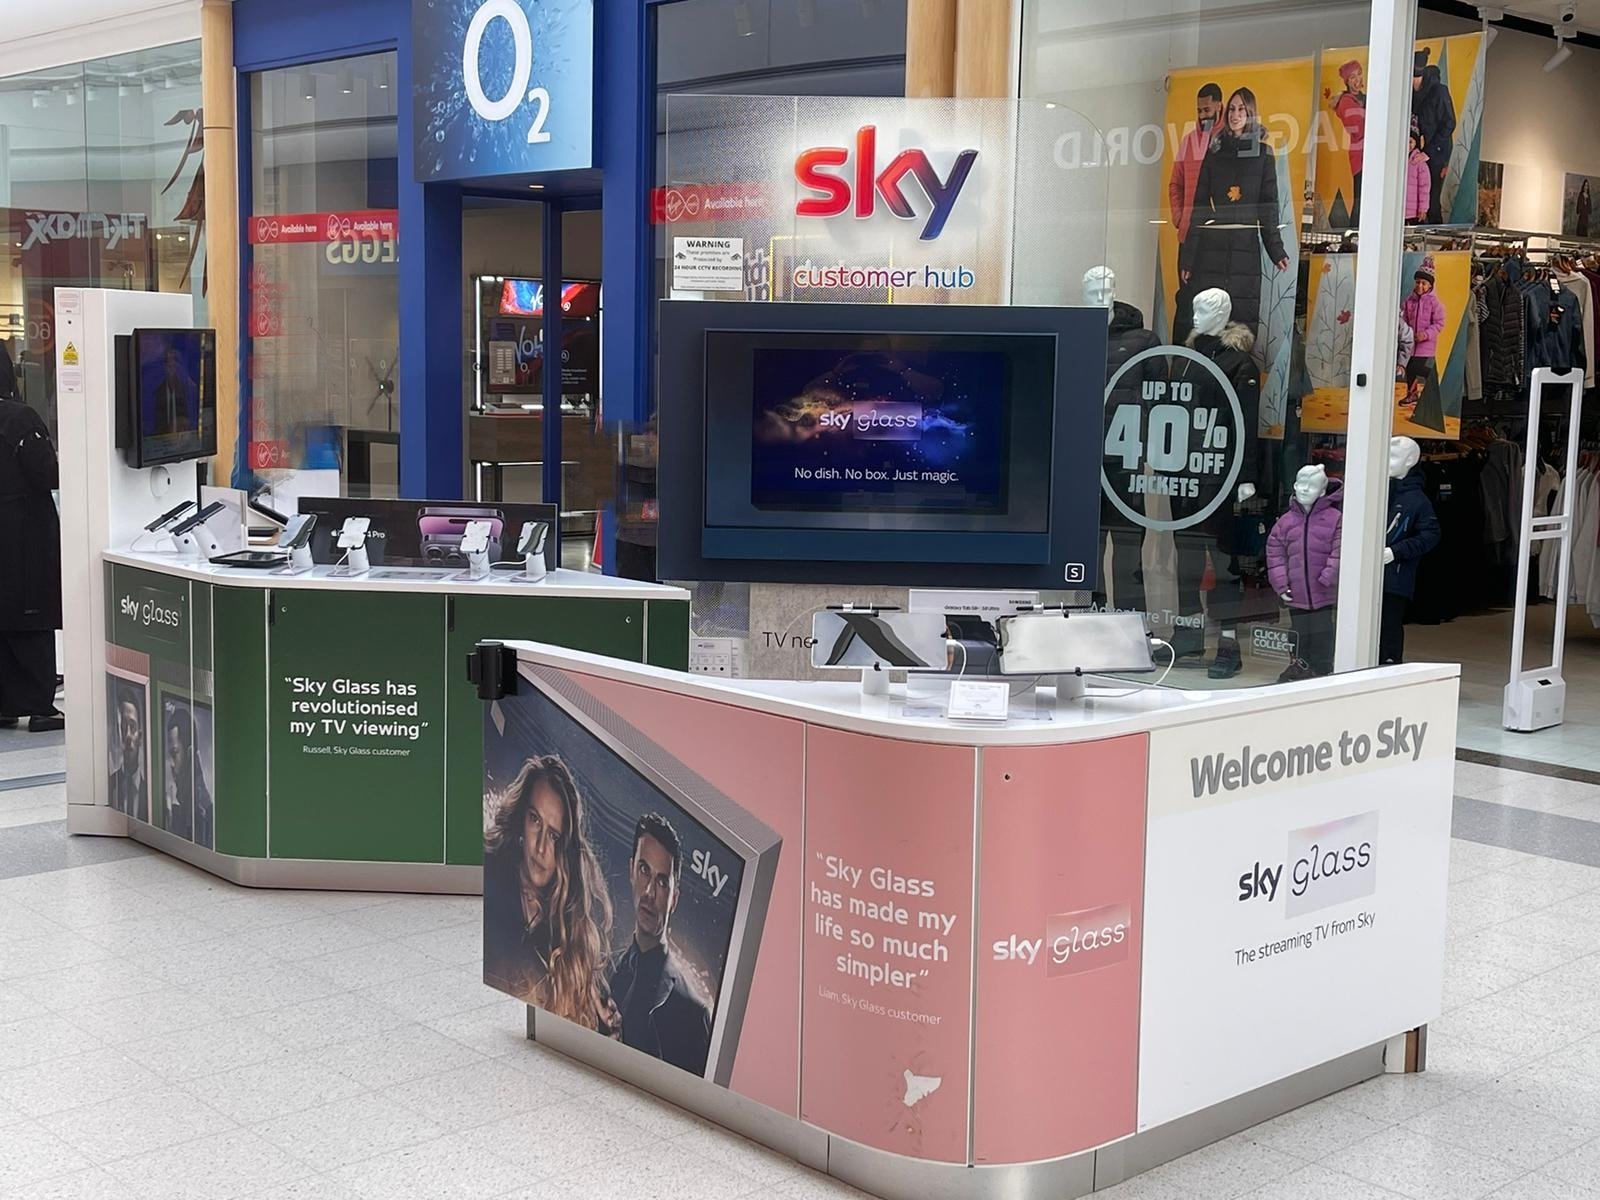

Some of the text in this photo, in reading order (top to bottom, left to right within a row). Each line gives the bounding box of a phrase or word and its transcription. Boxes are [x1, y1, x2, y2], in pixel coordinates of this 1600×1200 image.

[794, 124, 979, 242] sky
[281, 223, 317, 233] Available here
[354, 221, 393, 231] Available here
[686, 240, 731, 248] WARNING
[794, 266, 916, 288] customer
[925, 265, 975, 288] hub
[1142, 380, 1193, 401] UP TO
[820, 410, 917, 432] sky glass
[1189, 452, 1225, 475] OFF
[794, 467, 959, 484] No dish. No box. Just magic.
[1128, 474, 1199, 498] JACKETS
[120, 594, 179, 627] sky glass
[1162, 609, 1205, 629] Travel
[762, 631, 787, 648] TV
[1253, 638, 1295, 652] COLLECT
[1254, 629, 1280, 641] CLICK
[332, 678, 380, 695] Glass
[386, 680, 417, 696] has
[291, 699, 418, 717] revolutionised
[290, 720, 316, 736] my
[321, 719, 347, 735] TV
[333, 746, 348, 756] Sky
[349, 746, 371, 756] Glass
[372, 747, 410, 757] customer
[1190, 716, 1428, 799] Welcome to Sky
[690, 849, 729, 897] sky
[870, 867, 935, 898] Glass
[1238, 842, 1371, 902] sky glass
[810, 881, 957, 936] has made my
[815, 912, 949, 962] life so much
[992, 923, 1125, 965] sky glass
[1235, 912, 1376, 966] The streaming TV from Sky
[842, 993, 858, 1010] Sky
[858, 999, 886, 1016] Glass
[887, 1006, 942, 1026] customer
